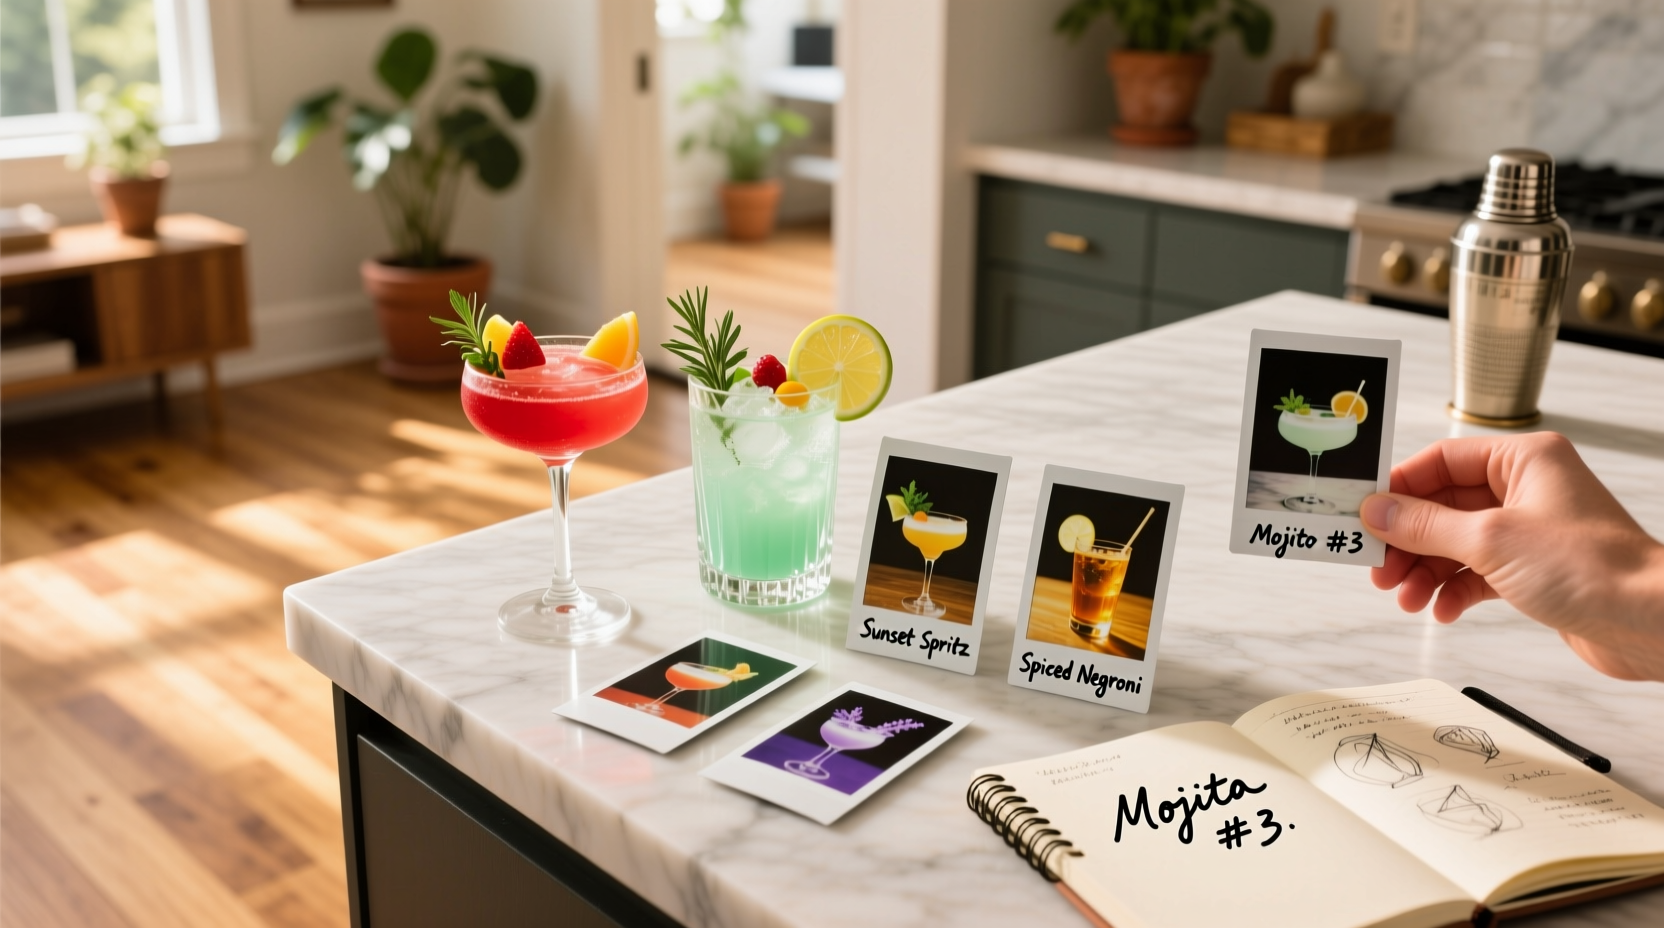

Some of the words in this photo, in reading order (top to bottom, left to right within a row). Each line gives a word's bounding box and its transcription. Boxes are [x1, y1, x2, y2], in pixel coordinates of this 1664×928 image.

[1249, 523, 1317, 558] Mojito
[1326, 529, 1364, 554] #3
[860, 617, 916, 647] Sunset
[919, 630, 971, 660] Spritz
[1019, 651, 1075, 682] Spiced
[1076, 664, 1143, 698] Negroni
[1114, 772, 1267, 844] Mojita
